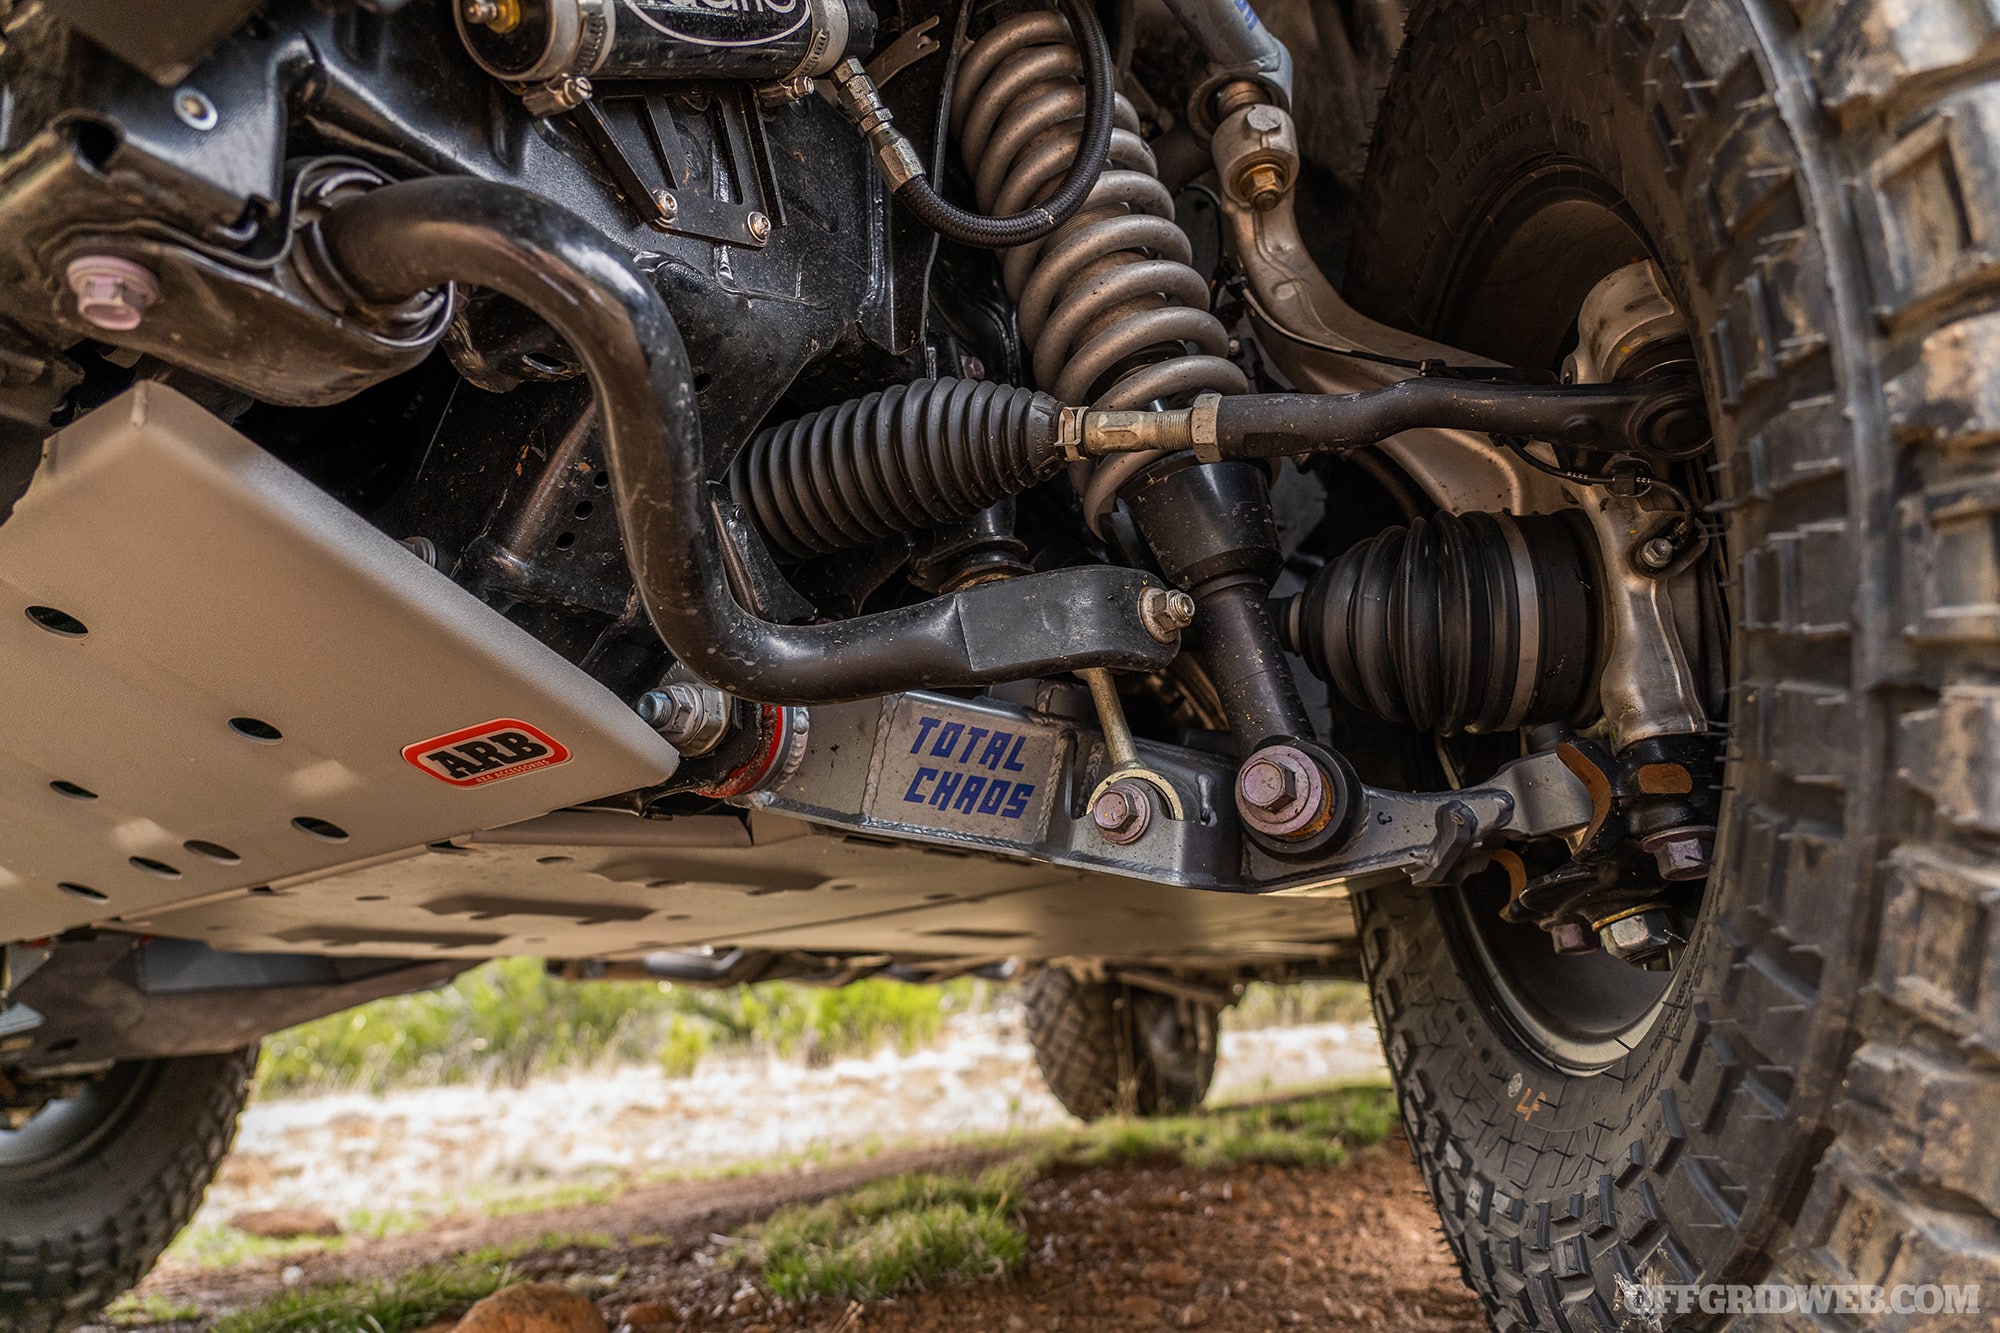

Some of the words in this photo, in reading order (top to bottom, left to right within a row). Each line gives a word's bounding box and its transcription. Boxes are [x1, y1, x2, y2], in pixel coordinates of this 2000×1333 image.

[425, 731, 548, 779] ARB
[494, 759, 551, 778] ACCESSORIES
[910, 716, 1027, 772] TOTAL
[903, 767, 1036, 819] CHAOS
